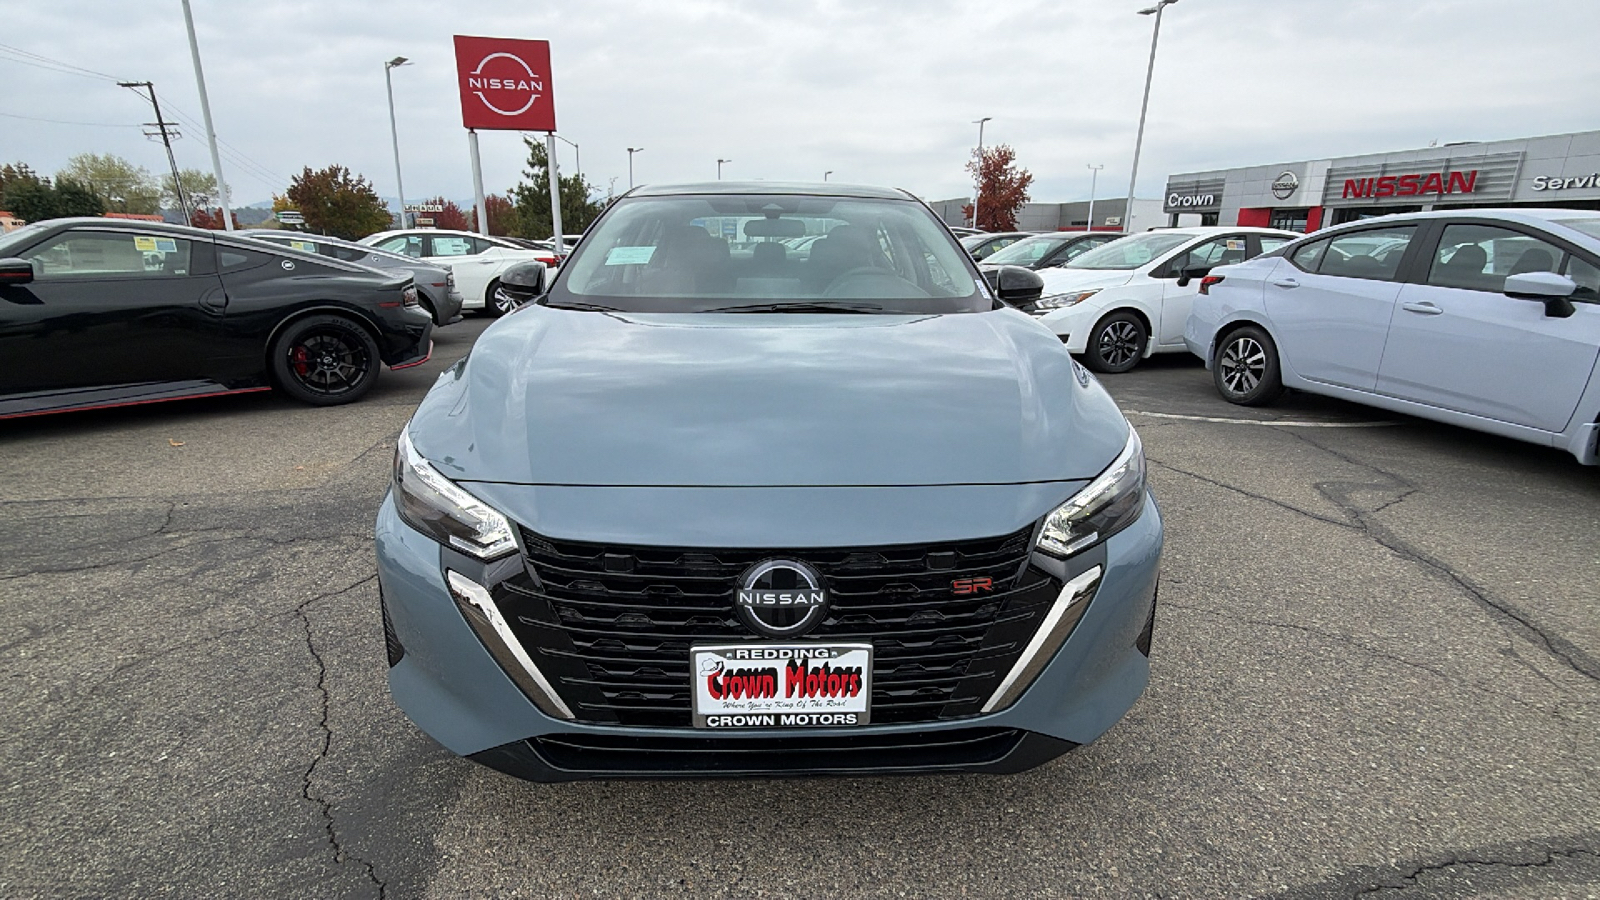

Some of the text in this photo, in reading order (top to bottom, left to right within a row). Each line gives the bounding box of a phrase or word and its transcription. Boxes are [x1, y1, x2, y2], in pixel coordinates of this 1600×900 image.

[469, 77, 543, 91] NISSAN
[1342, 170, 1478, 199] NISSAN
[1168, 193, 1214, 207] Crown
[952, 577, 993, 594] SR
[740, 592, 824, 605] NISSAN
[736, 649, 829, 659] REDDING
[707, 660, 863, 700] Crown Motors
[722, 700, 847, 711] Where You're King Of The Road
[707, 713, 858, 727] CROWN MOTORS
